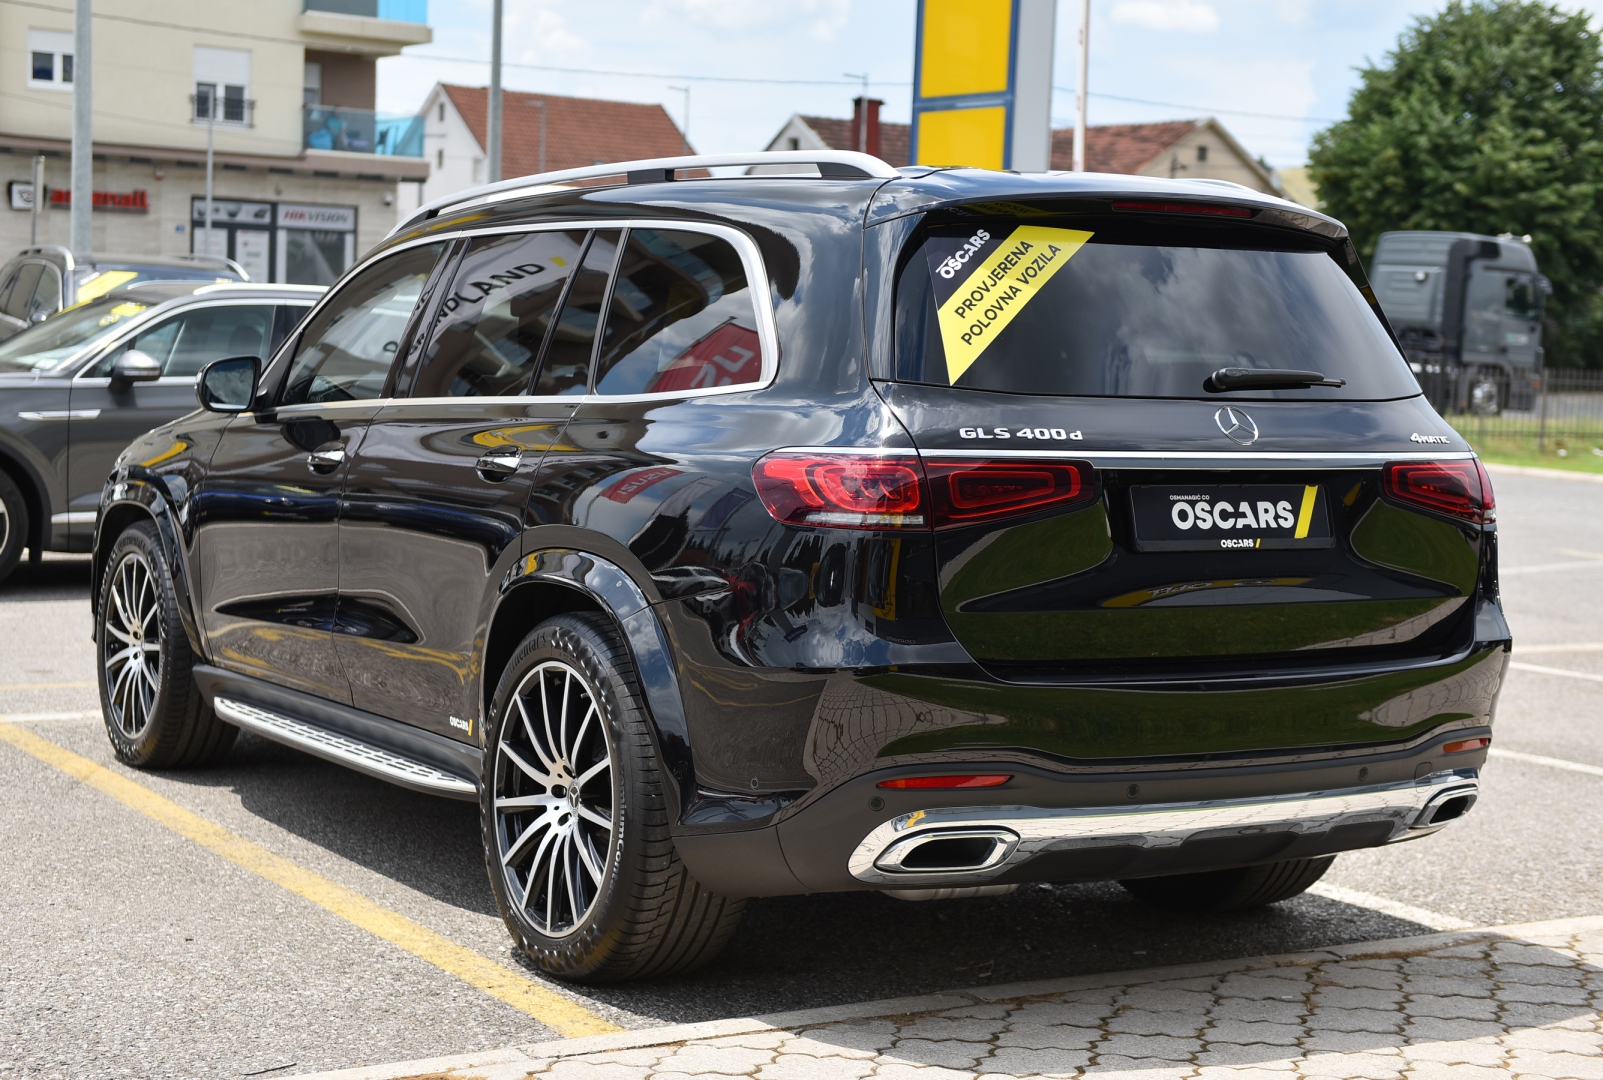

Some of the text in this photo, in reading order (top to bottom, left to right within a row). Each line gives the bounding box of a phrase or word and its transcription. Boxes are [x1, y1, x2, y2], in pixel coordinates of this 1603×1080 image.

[51, 188, 148, 208] arenall
[283, 209, 349, 224] HIKVISION
[940, 229, 991, 279] OSCARS
[954, 240, 1034, 319] PROVJERENA
[960, 243, 1062, 346] POLOVNA VOZILA
[959, 427, 1011, 440] GLS
[1409, 432, 1451, 444] 4MATIC
[1171, 500, 1295, 530] OSCARS
[1220, 538, 1254, 548] OSCARS
